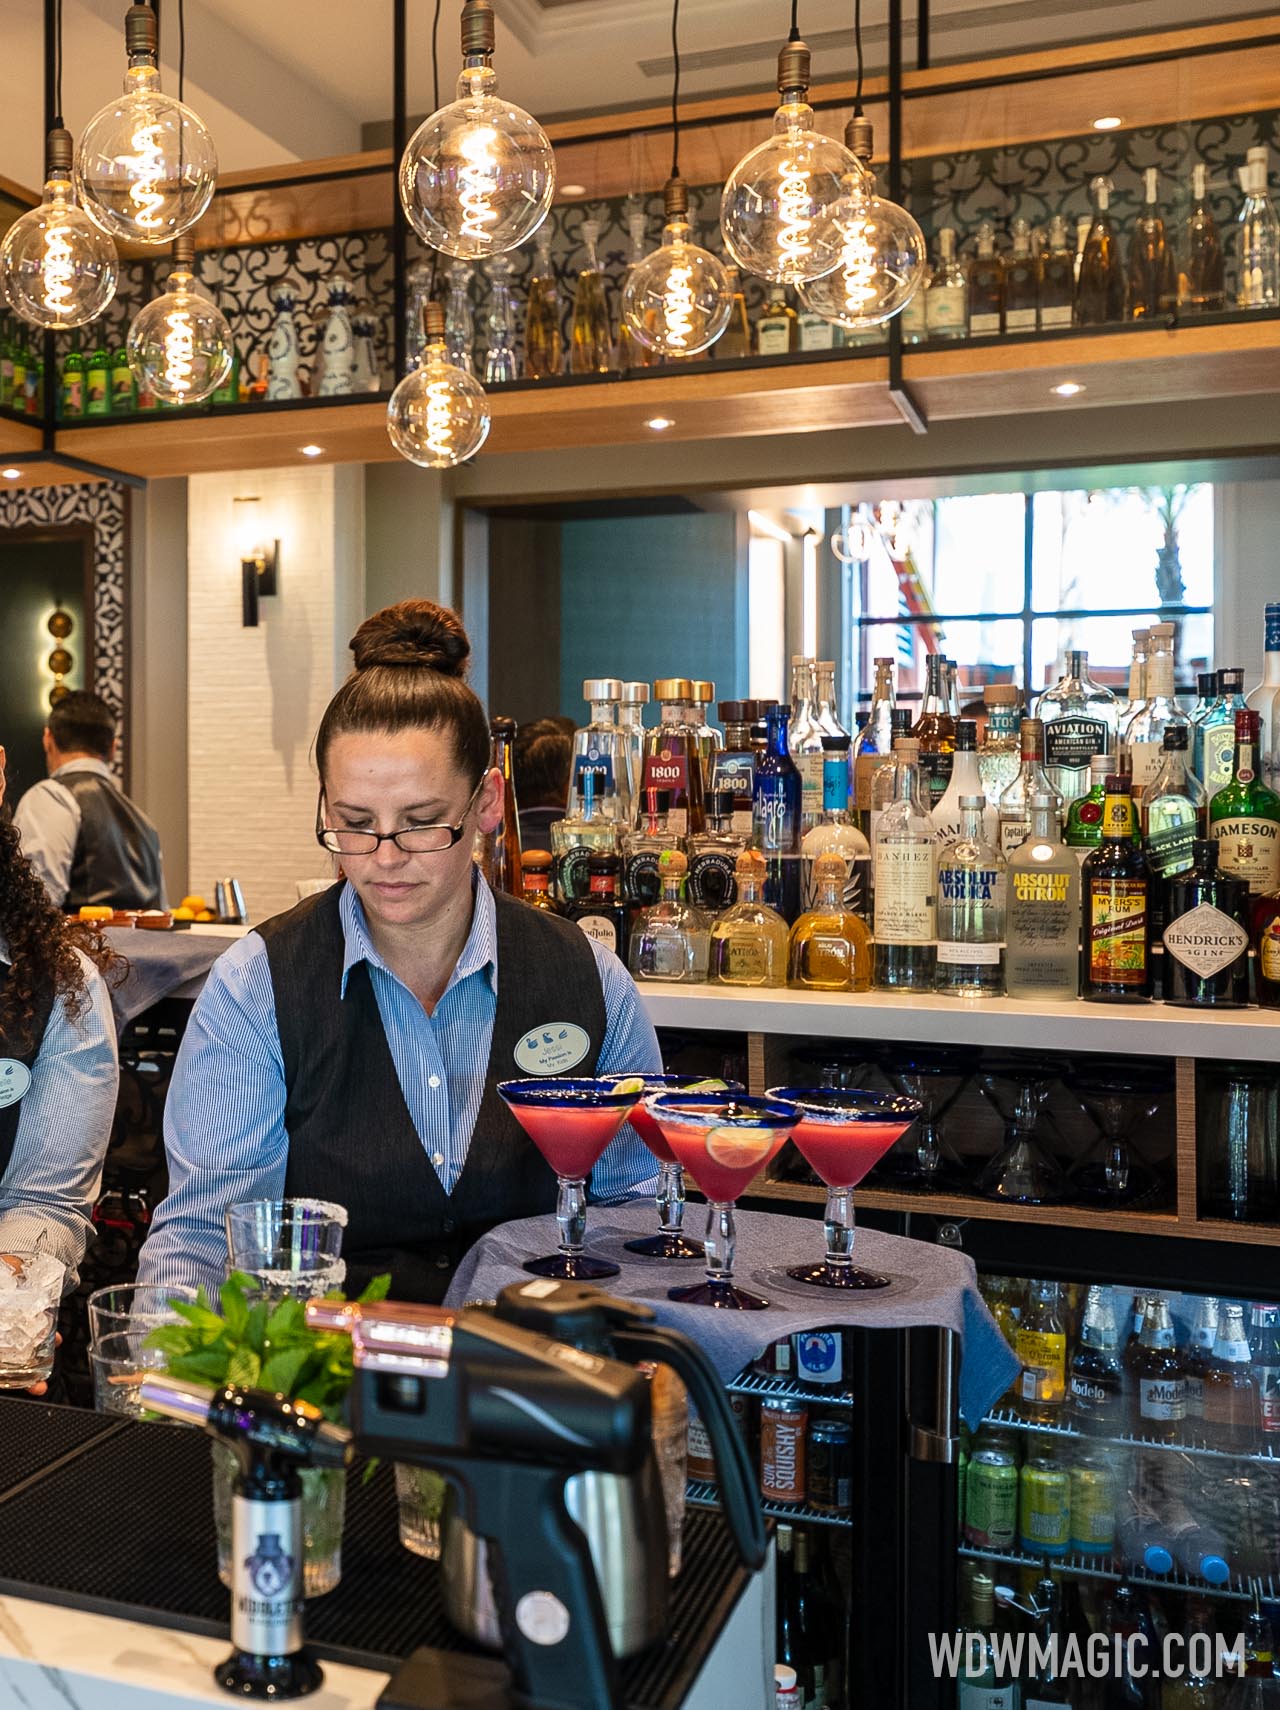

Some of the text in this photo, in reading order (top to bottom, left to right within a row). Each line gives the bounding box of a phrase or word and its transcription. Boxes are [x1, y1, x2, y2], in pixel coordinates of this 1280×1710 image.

[990, 716, 1015, 728] LTOS
[1047, 723, 1103, 735] AVIATION
[651, 766, 680, 778] 1800
[718, 777, 748, 789] 1800
[1004, 826, 1028, 838] Captain
[1214, 823, 1277, 839] JAMESON
[1172, 835, 1199, 847] LABEL
[695, 859, 731, 875] HERRADURA
[938, 870, 998, 885] ABSOLUT
[1013, 873, 1072, 887] ABSOLUT
[942, 885, 992, 899] VODKA
[1016, 887, 1067, 901] CITRON
[1098, 898, 1140, 906] MYERS'S
[1108, 905, 1131, 913] RUM
[1093, 917, 1144, 937] Original Dark
[1168, 934, 1243, 946] HENDRICK'S
[1133, 1289, 1161, 1298] IMPORT
[1070, 1377, 1105, 1399] Modelo
[776, 1423, 796, 1490] SQUISHY
[763, 1463, 776, 1488] SUN
